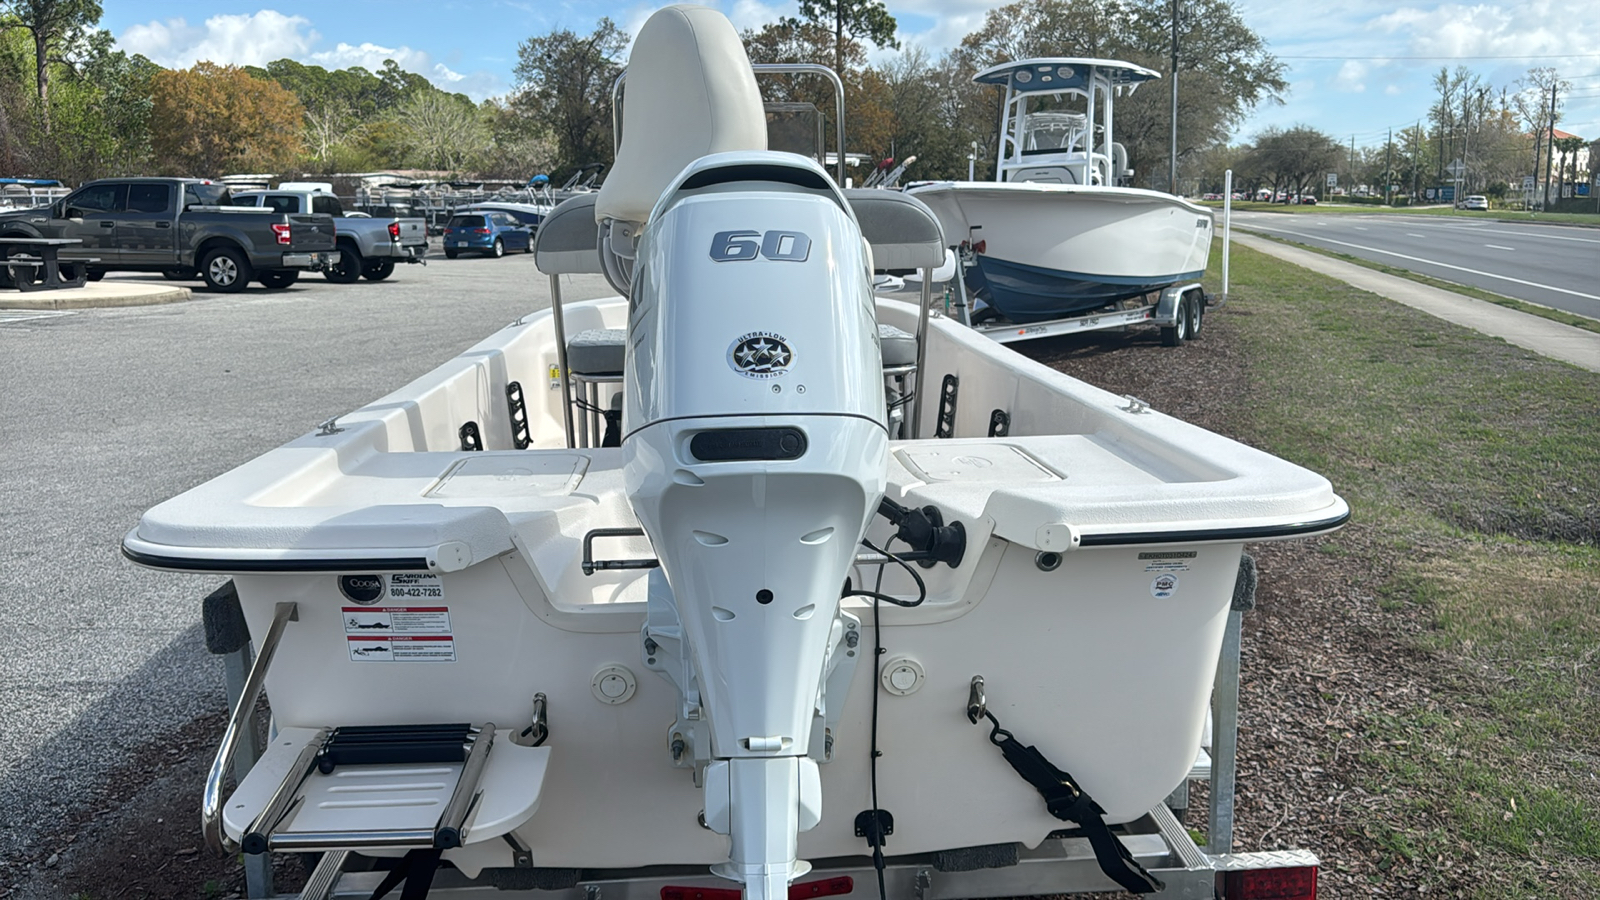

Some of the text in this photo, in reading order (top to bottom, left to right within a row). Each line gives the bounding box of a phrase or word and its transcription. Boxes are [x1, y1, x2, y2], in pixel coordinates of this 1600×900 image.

[709, 229, 813, 263] 60
[744, 371, 784, 379] EMISSION
[391, 576, 418, 584] SKIFF
[391, 588, 442, 597] 800-422-7282
